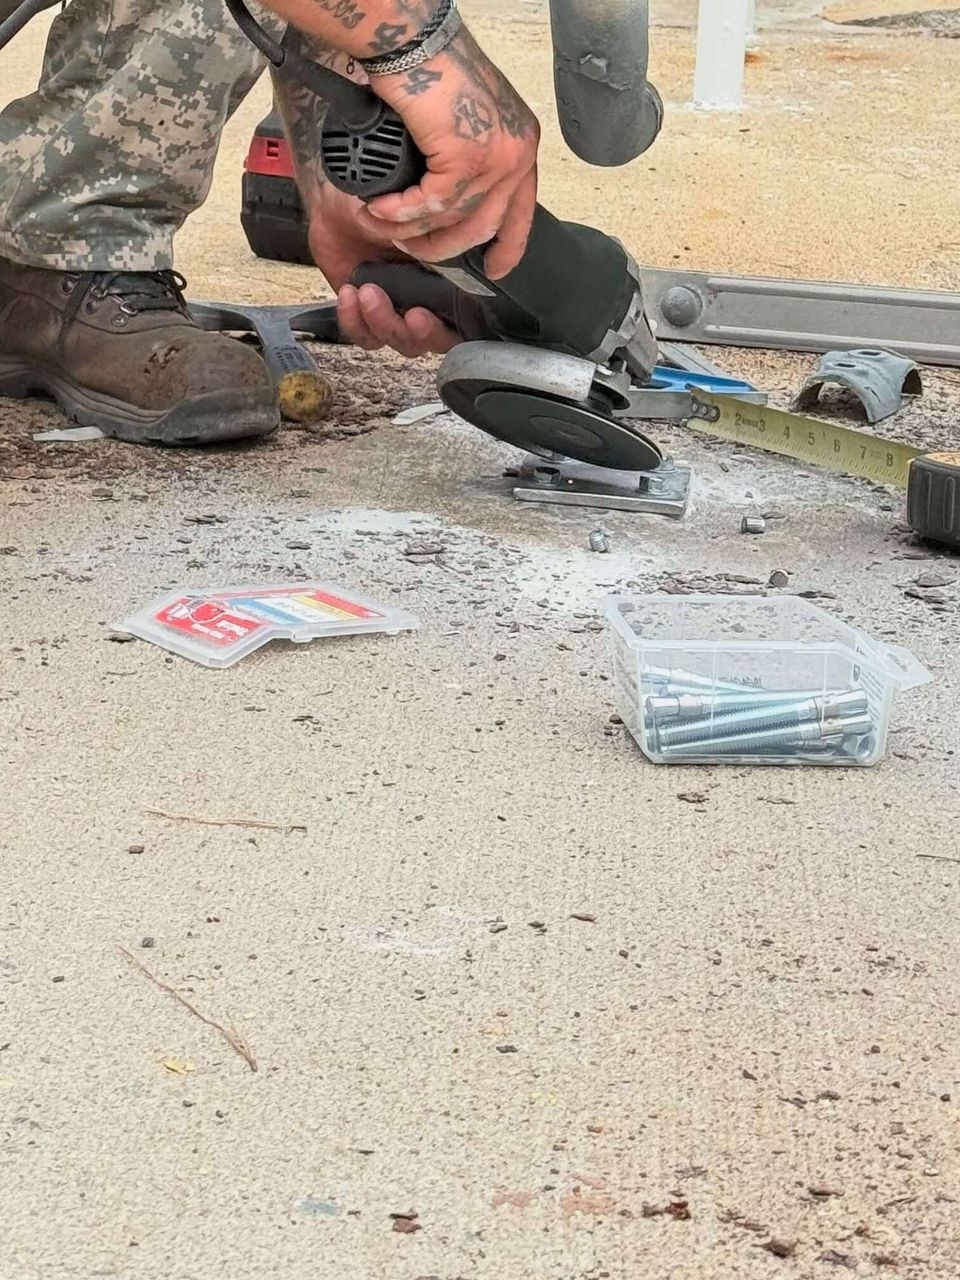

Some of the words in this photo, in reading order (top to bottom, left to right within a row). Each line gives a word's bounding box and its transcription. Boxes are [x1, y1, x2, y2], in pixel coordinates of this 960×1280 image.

[735, 412, 742, 426] 2
[759, 419, 766, 432] 3
[783, 426, 790, 440] 4
[808, 432, 815, 446] 5
[833, 438, 841, 452] 6
[859, 445, 867, 459] 7
[886, 452, 894, 466] 8
